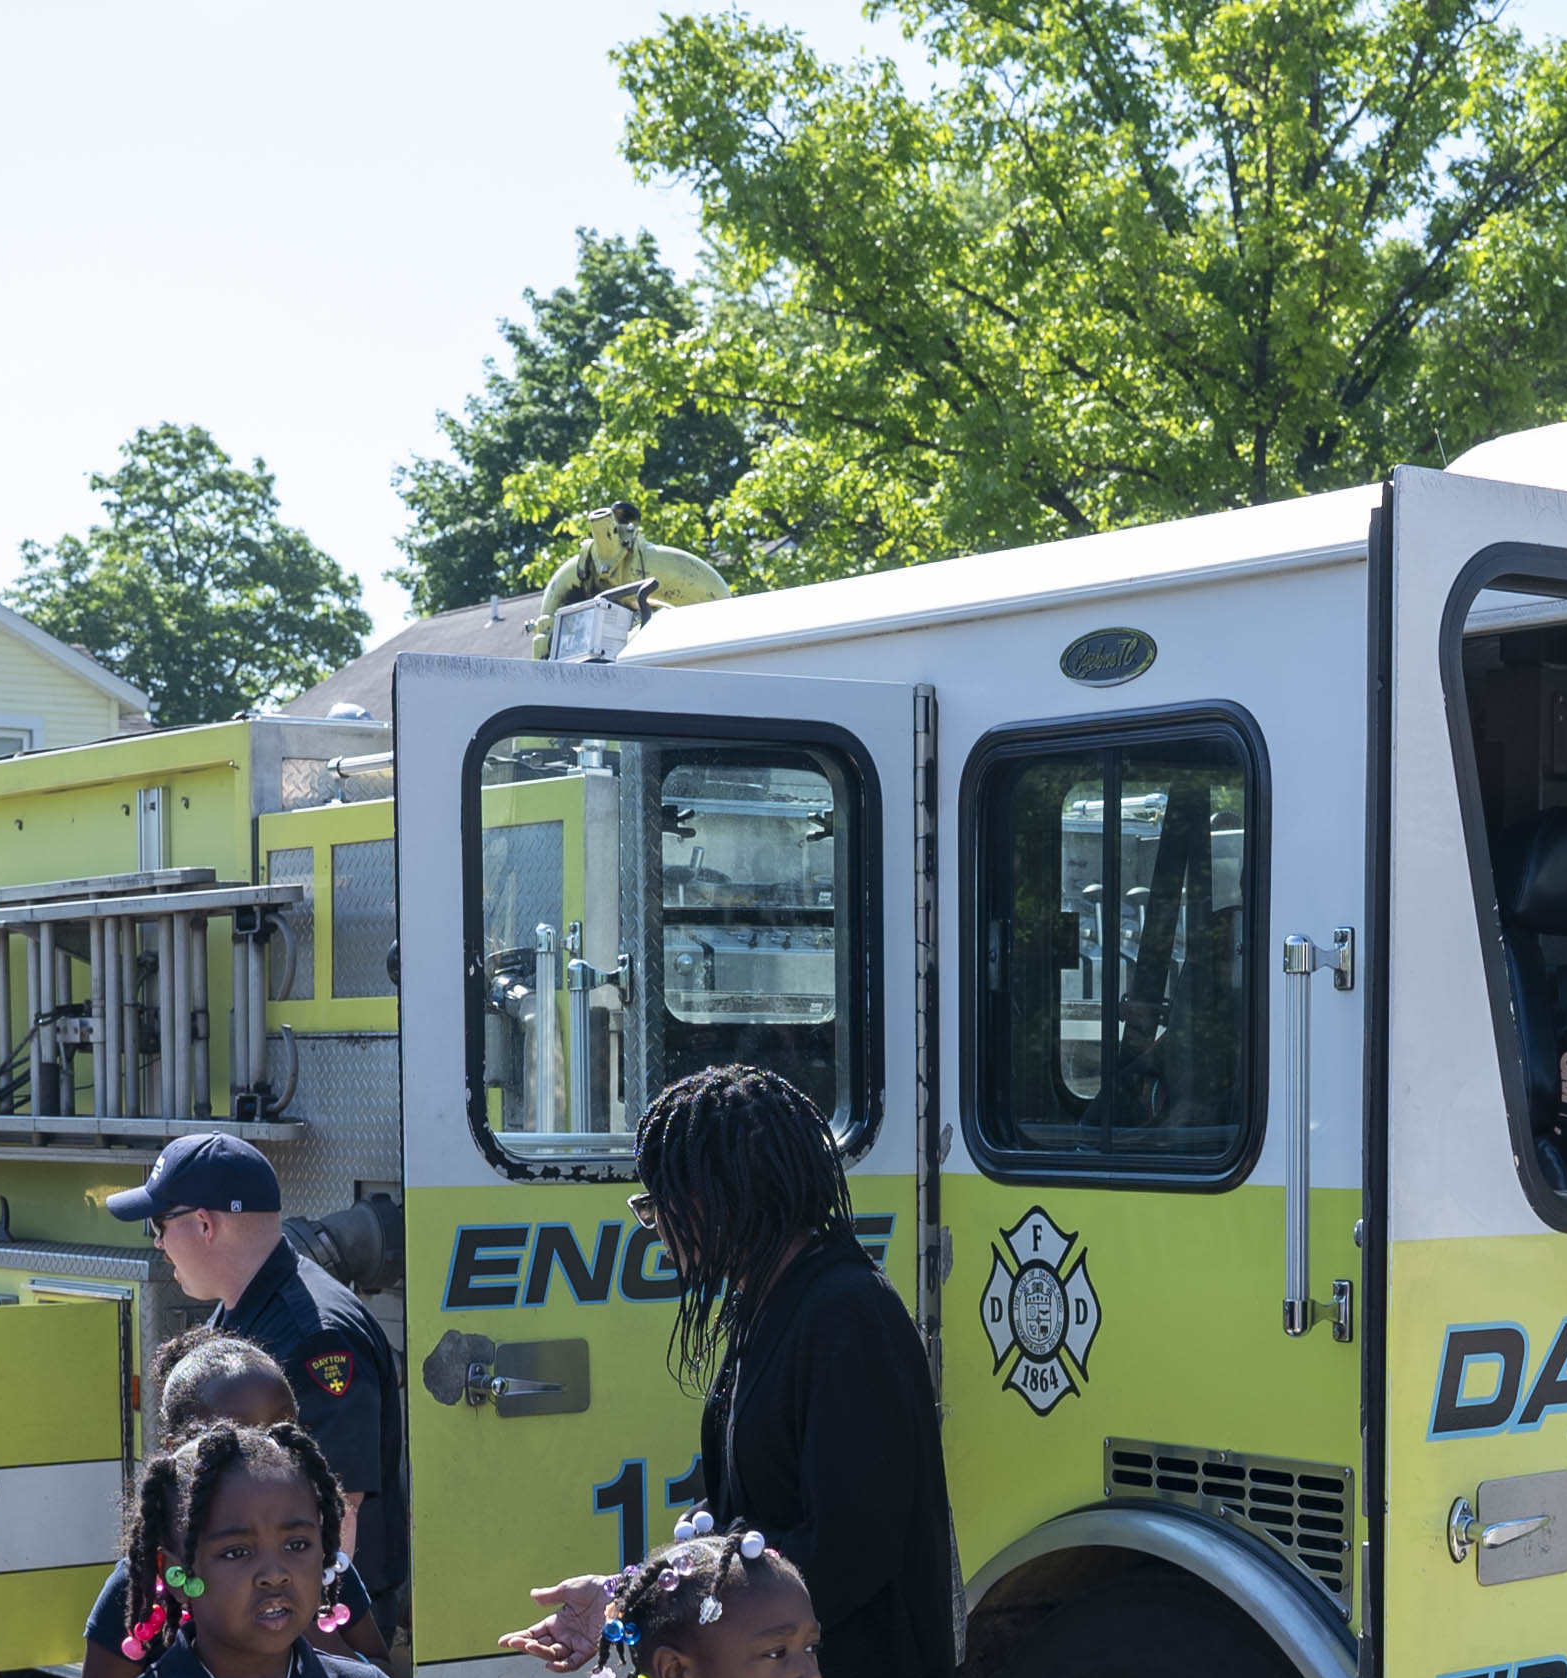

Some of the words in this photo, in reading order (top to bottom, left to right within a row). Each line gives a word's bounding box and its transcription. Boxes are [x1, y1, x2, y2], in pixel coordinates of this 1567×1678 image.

[1031, 1225, 1042, 1252] F
[441, 1213, 896, 1311] ENG
[990, 1296, 1003, 1323] D
[1075, 1298, 1089, 1325] D
[312, 1355, 347, 1370] DAYTON
[1020, 1365, 1059, 1393] 1864
[592, 1453, 708, 1574] 1
